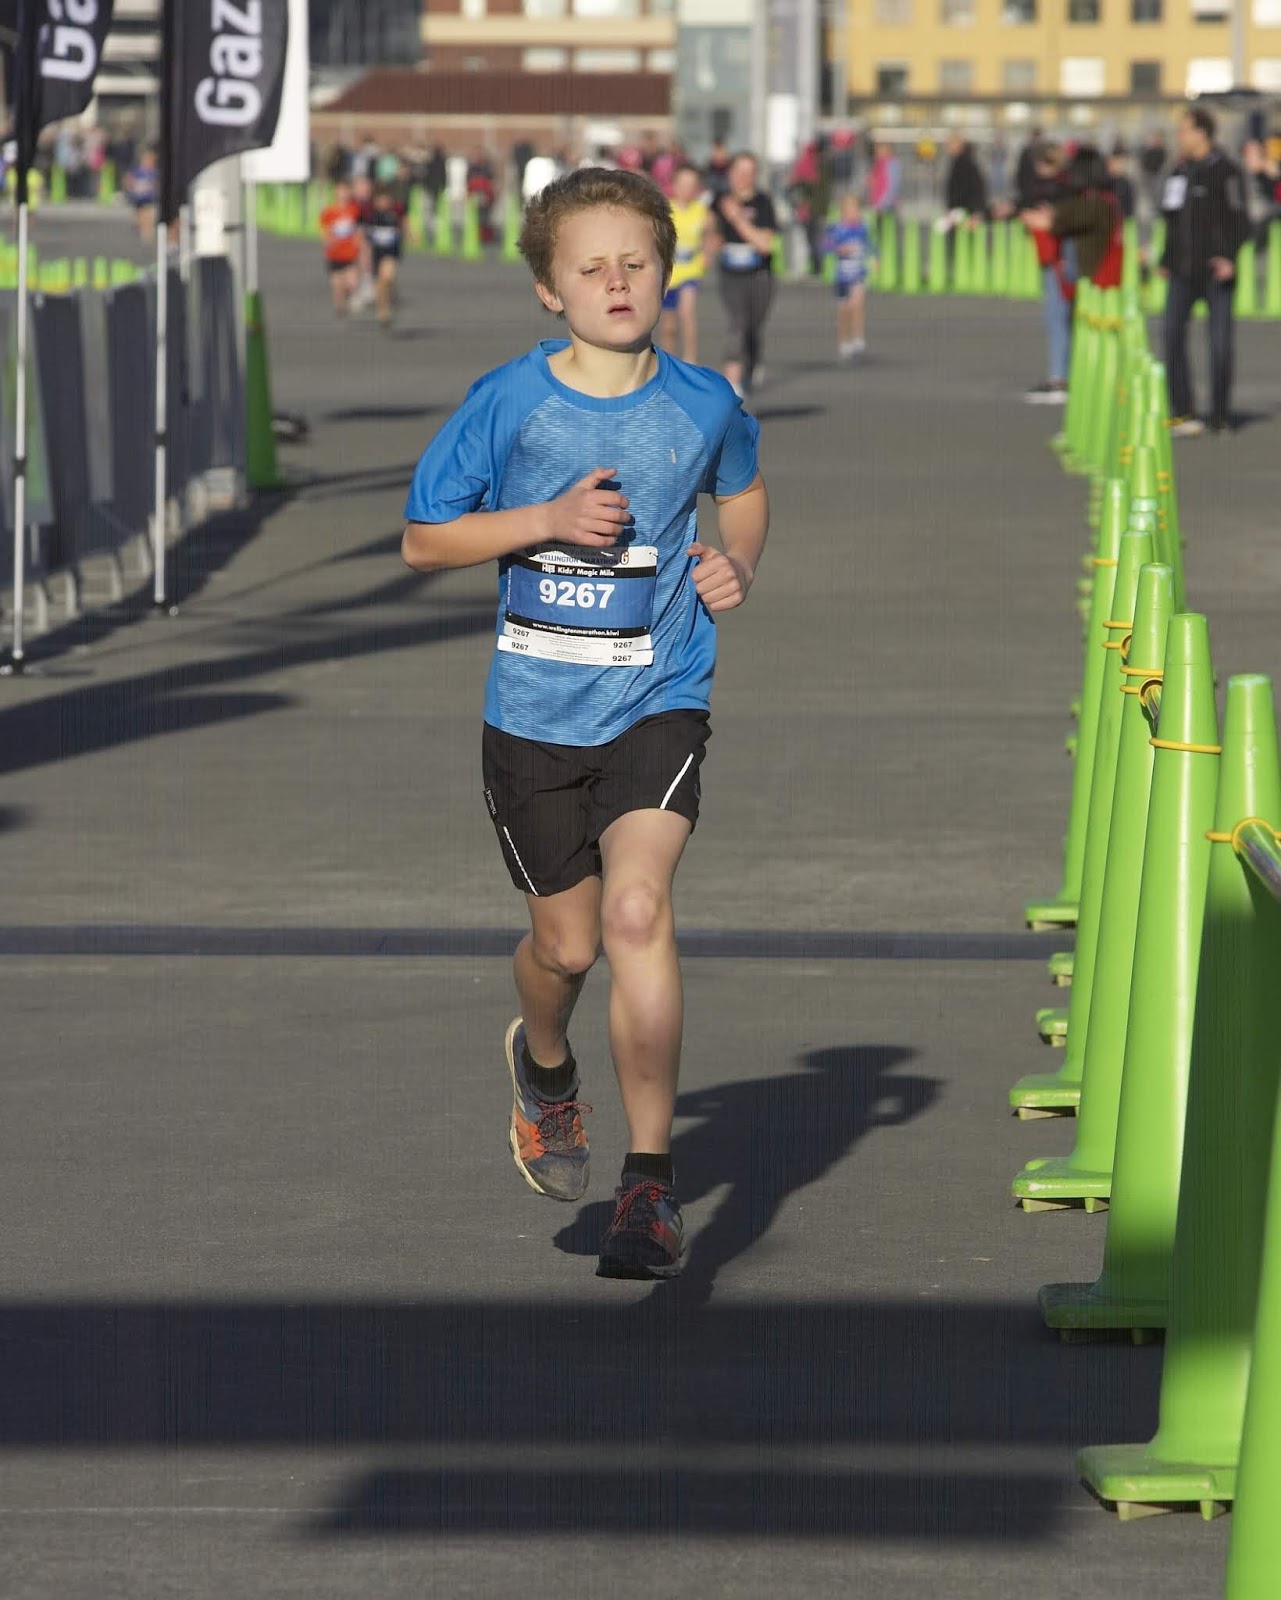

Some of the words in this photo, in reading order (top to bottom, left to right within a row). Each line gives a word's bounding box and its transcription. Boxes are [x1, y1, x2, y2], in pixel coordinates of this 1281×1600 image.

[539, 554, 579, 564] WELLINGTON
[577, 568, 598, 577] Magic
[599, 569, 615, 577] Mile
[539, 578, 615, 609] 9267
[512, 627, 530, 638] 9267
[532, 622, 620, 636] www.wellingtonmarathon.kiwi
[511, 641, 529, 651] 9267
[613, 641, 633, 649] 9267
